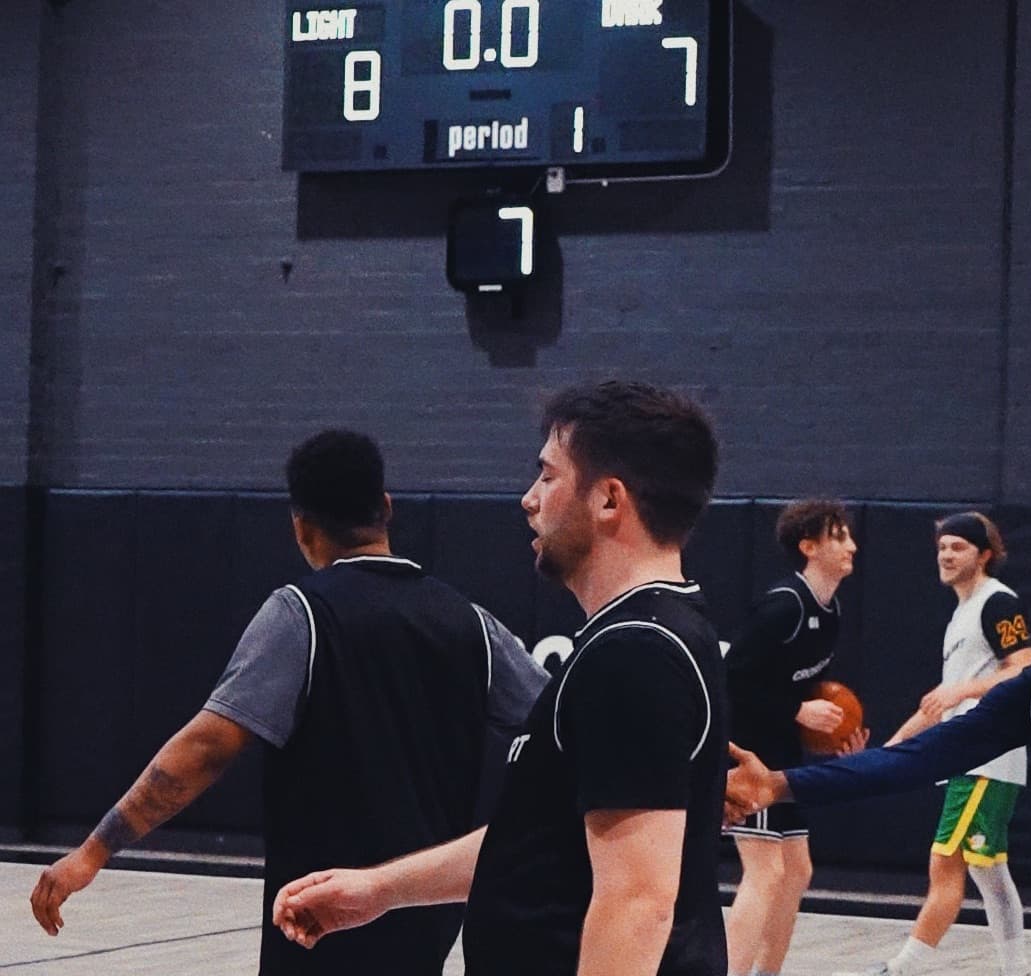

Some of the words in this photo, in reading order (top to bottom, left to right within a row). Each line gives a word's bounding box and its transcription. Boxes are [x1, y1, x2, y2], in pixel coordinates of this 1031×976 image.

[292, 9, 357, 42] LIGHT
[443, 0, 539, 70] 0.0
[343, 50, 381, 121] 8
[661, 37, 698, 106] 7
[448, 116, 528, 157] period
[573, 106, 584, 153] 1
[498, 206, 534, 275] 7
[996, 614, 1031, 649] 24
